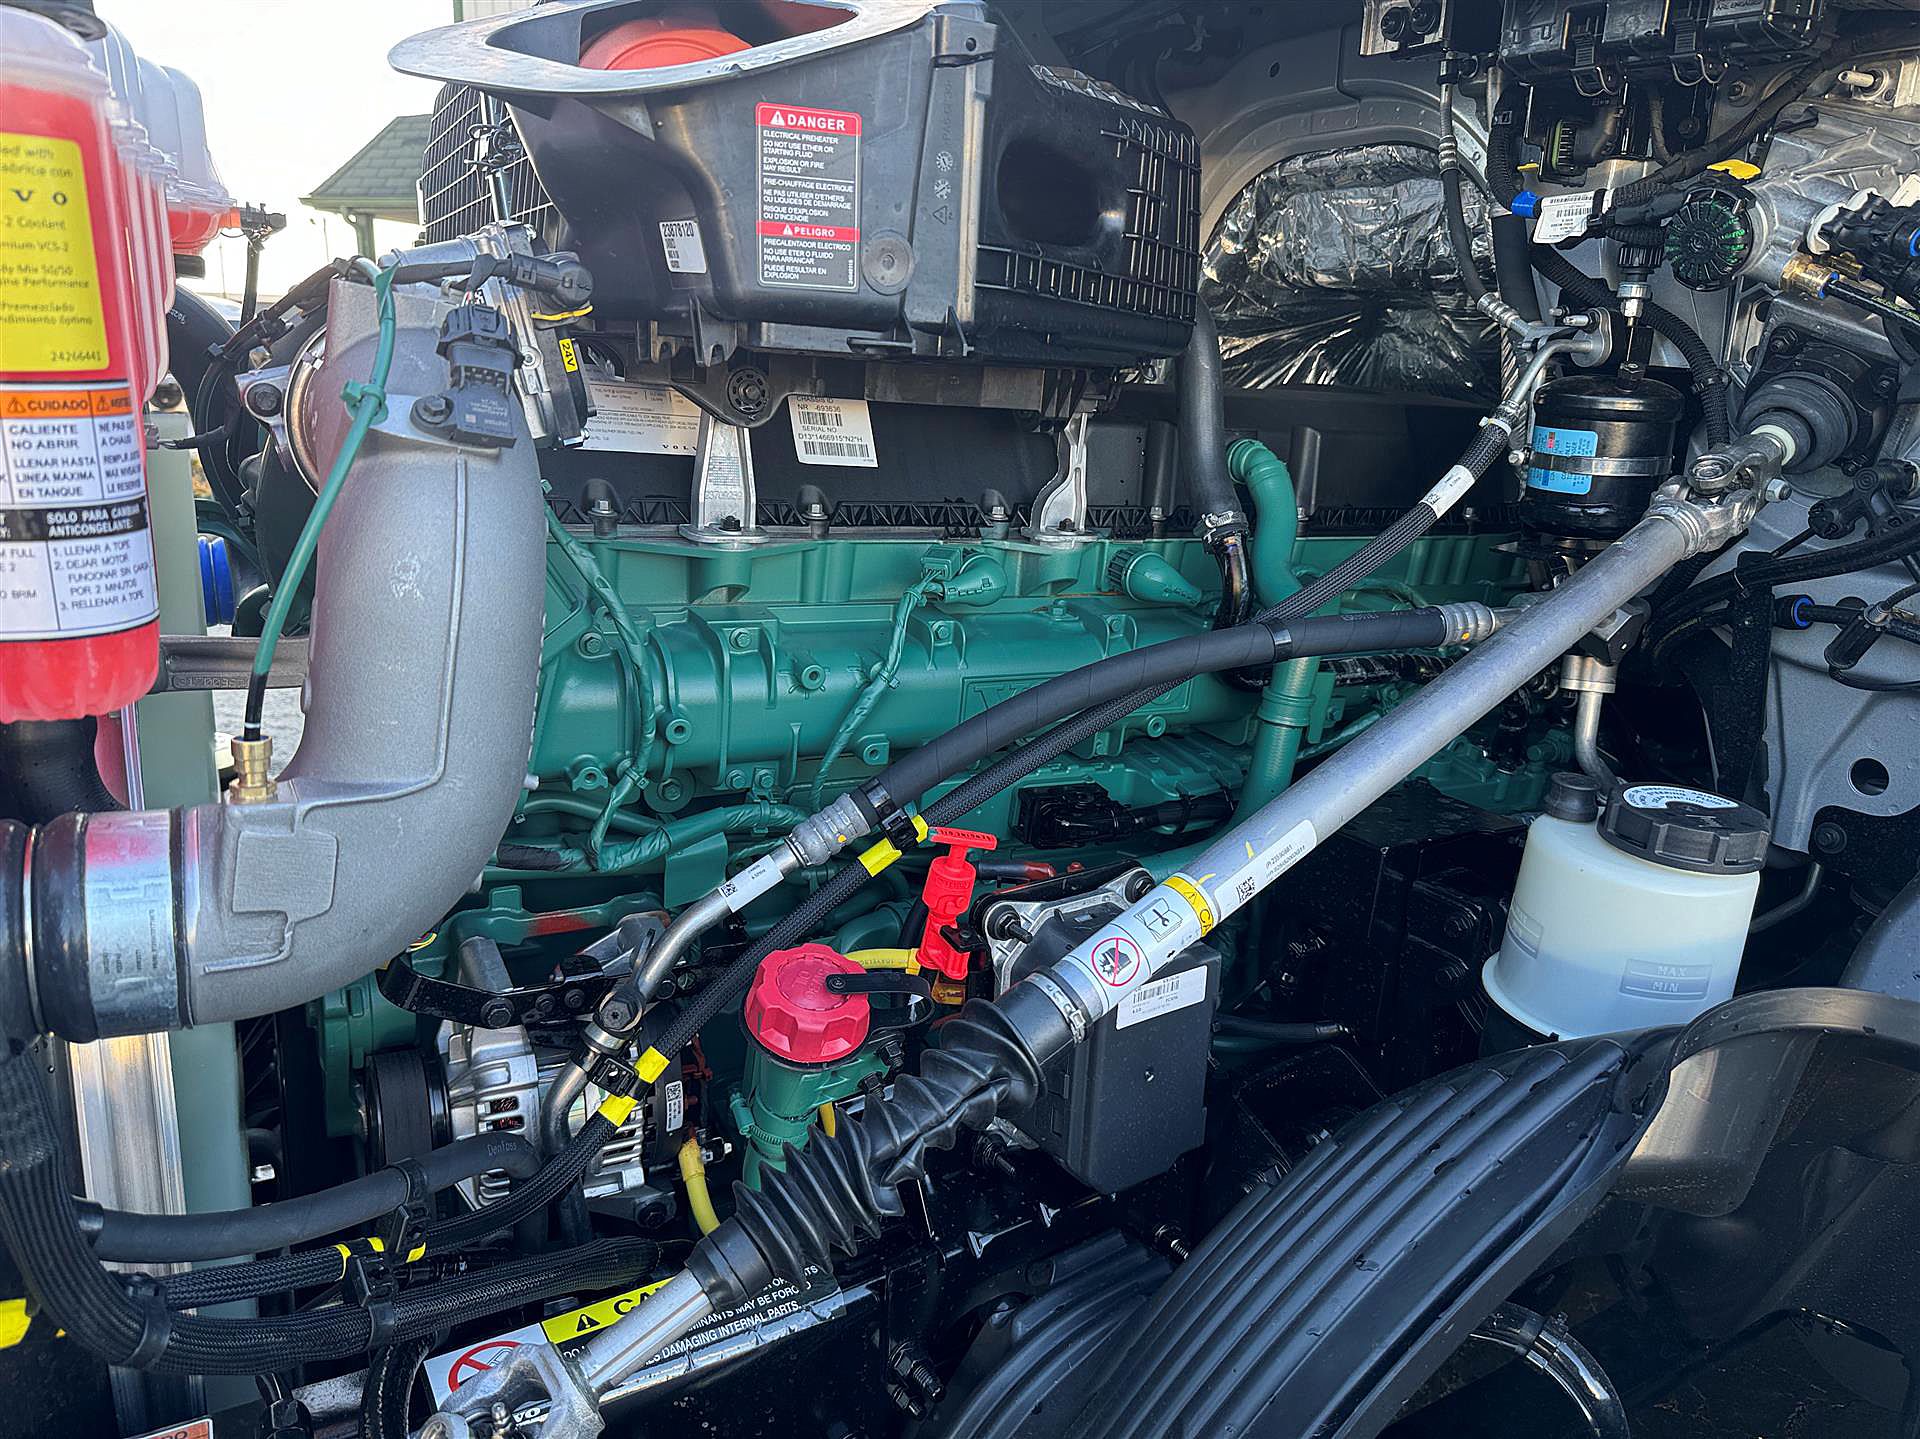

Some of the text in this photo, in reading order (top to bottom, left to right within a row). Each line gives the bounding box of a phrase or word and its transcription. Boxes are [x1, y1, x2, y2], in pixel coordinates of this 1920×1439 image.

[787, 113, 845, 131] DANGER
[763, 130, 839, 144] ELECTRICAL PREHEATER
[763, 147, 813, 158] STARTING FLUID
[774, 140, 787, 148] NOT
[788, 142, 801, 150] USE
[802, 143, 823, 152] ETHER
[824, 146, 834, 154] OR
[763, 156, 825, 169] EXPLOSION OR FIRE
[777, 165, 801, 174] RESULT
[763, 178, 854, 193] PRE-CHAUFFAGE ELECTRIQUE
[773, 189, 786, 197] PAS
[786, 190, 814, 200] UTILISER
[814, 192, 845, 202] D'ETHERS
[763, 195, 852, 210] OU LIQUIDES DE DEMARRAGE
[763, 205, 829, 217] RISQUE D'EXPLOSION
[774, 213, 809, 222] D'INCENDIE
[794, 227, 835, 237] PELIGRO
[763, 237, 851, 251] PRECALENTADOR ELECTRICO
[774, 248, 787, 256] USE
[788, 250, 804, 258] ETER
[811, 251, 834, 260] FLUIDO
[780, 256, 815, 265] ARRANCAR
[763, 264, 827, 275] PUEDE RESULTAR EN
[763, 271, 800, 280] EXPLOSION
[561, 342, 575, 367] 24V
[28, 399, 89, 411] CUIDADO
[797, 403, 809, 411] NR
[9, 424, 79, 435] CALIENTE
[98, 422, 110, 433] NE
[111, 421, 126, 432] PAS
[802, 425, 826, 433] SERIAL
[11, 439, 80, 450] NO ABRIR
[662, 443, 697, 451] VOLV
[14, 455, 96, 469] LLENAR HASTA
[15, 473, 50, 483] LINEA
[52, 470, 95, 482] MAXIMA
[18, 486, 84, 499] EN TANQUE
[46, 511, 78, 525] SOLO
[82, 508, 109, 521] PARA
[10, 547, 35, 558] FULL
[53, 539, 131, 557] 1. LLENAR A TOPE
[10, 563, 16, 572] 2
[54, 553, 129, 571] 2. DEJAR MOTOR
[68, 569, 118, 584] FUNCIONAR
[121, 566, 132, 577] SIN
[11, 589, 37, 599] BRIM
[70, 578, 137, 597] POR 2 MINUTOS
[60, 589, 145, 611] 3. RELLENAR A TOPE
[1655, 965, 1688, 978] MAX
[1651, 980, 1680, 993] MIN
[757, 1294, 773, 1307] BE
[661, 1300, 802, 1358] DAMAGING INTERNAL PARTS.
